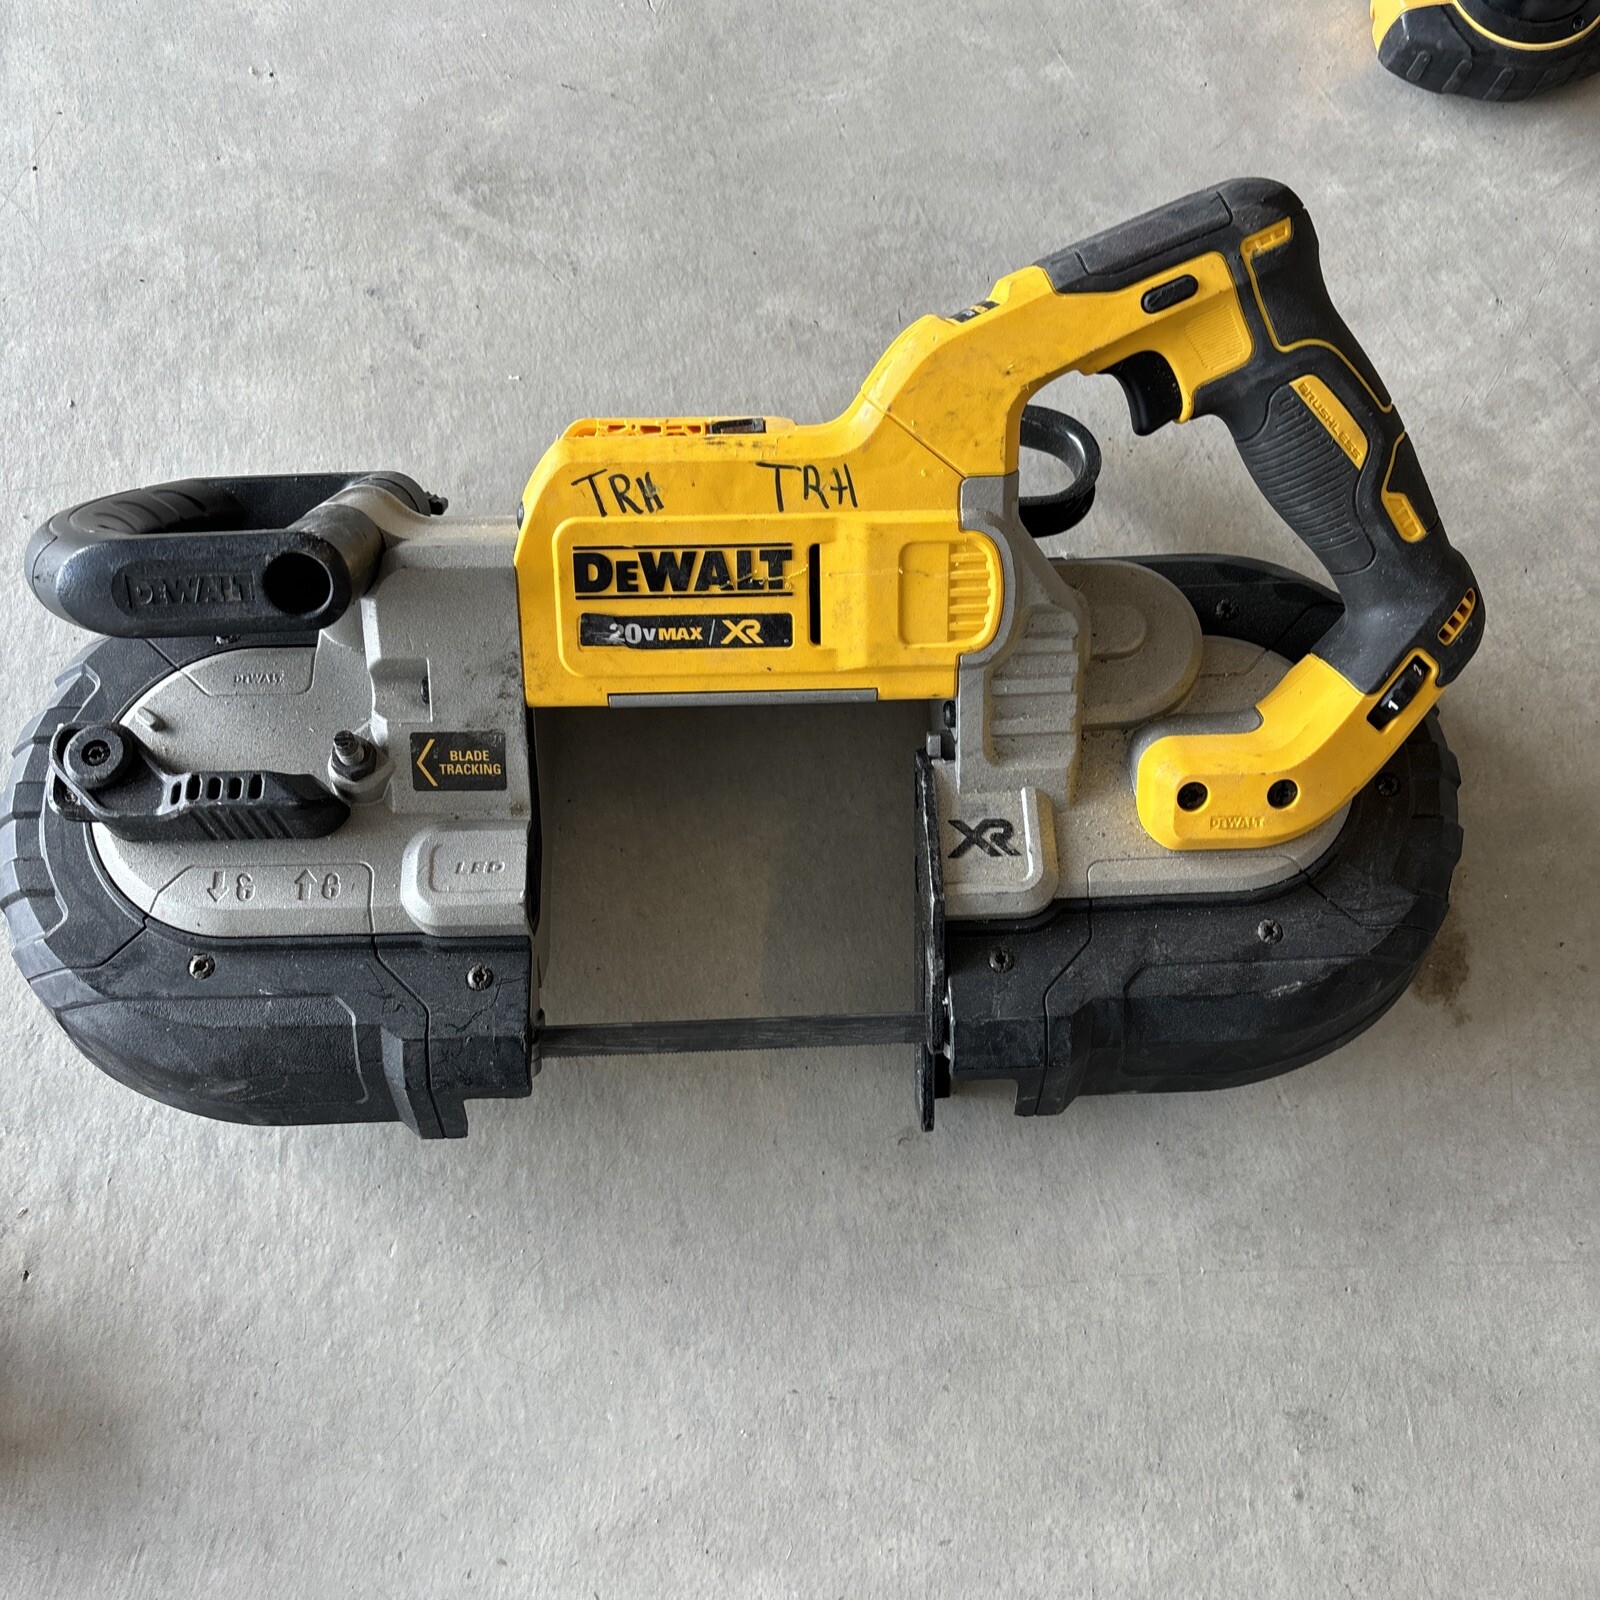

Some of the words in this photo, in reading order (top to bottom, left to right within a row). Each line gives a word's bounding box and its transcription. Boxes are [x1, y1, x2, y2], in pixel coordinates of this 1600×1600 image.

[1297, 382, 1363, 461] BRUSHLESS
[570, 468, 664, 517] TRH
[756, 461, 859, 513] TRH
[573, 549, 793, 594] DEWALT
[720, 619, 765, 644] XR
[439, 763, 502, 775] TRACKING
[449, 750, 490, 762] BLADE
[947, 818, 1022, 859] XR
